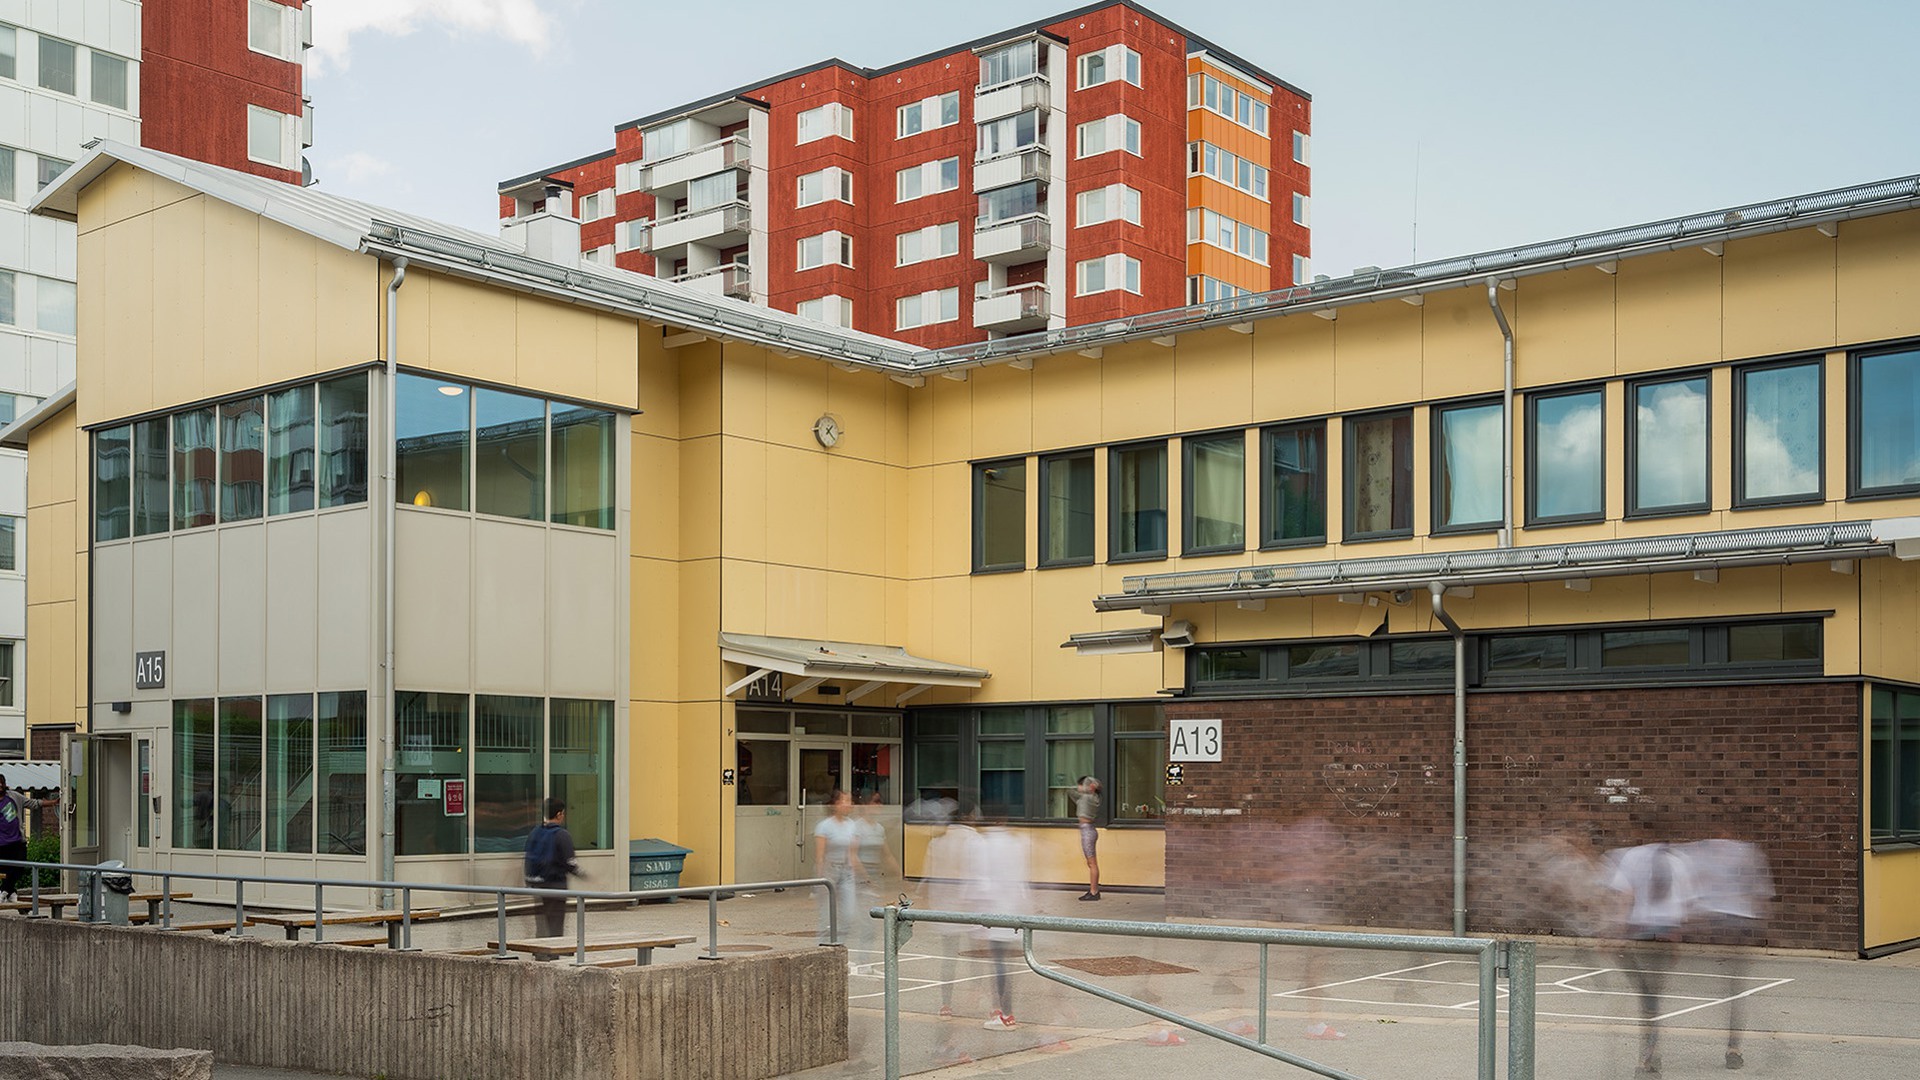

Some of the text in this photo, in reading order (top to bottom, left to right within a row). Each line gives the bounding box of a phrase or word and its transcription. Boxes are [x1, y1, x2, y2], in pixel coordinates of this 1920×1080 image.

[136, 656, 162, 683] A15
[749, 673, 782, 697] A14
[1172, 726, 1219, 755] A13
[645, 860, 672, 872] SAND
[643, 879, 669, 889] SISAB
